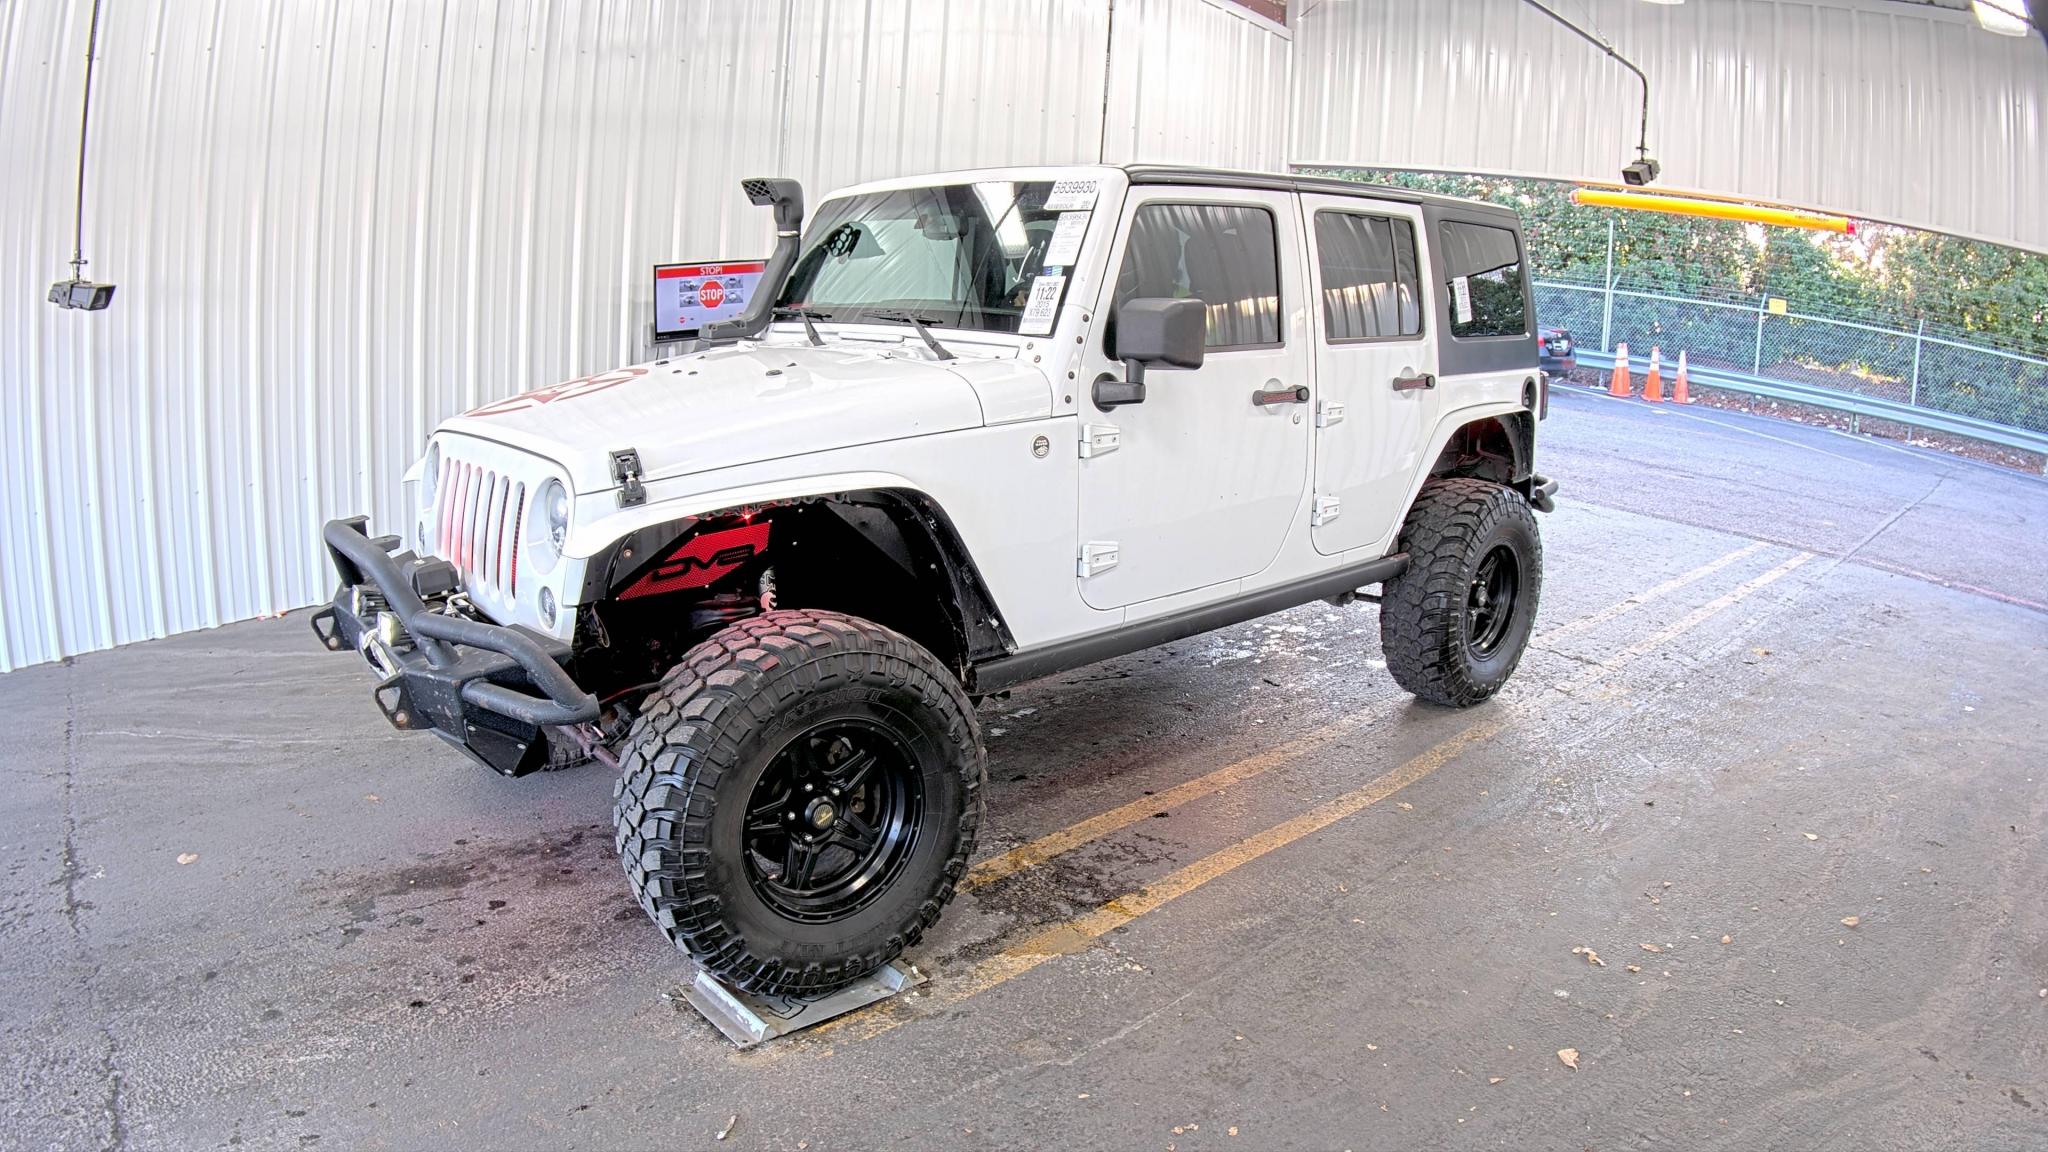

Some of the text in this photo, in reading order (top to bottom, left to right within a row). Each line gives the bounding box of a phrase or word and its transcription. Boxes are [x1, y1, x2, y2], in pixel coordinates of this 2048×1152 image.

[700, 266, 723, 275] STOP!
[700, 289, 723, 300] STOP
[1035, 286, 1057, 300] 11:22
[1035, 300, 1050, 308] 2015
